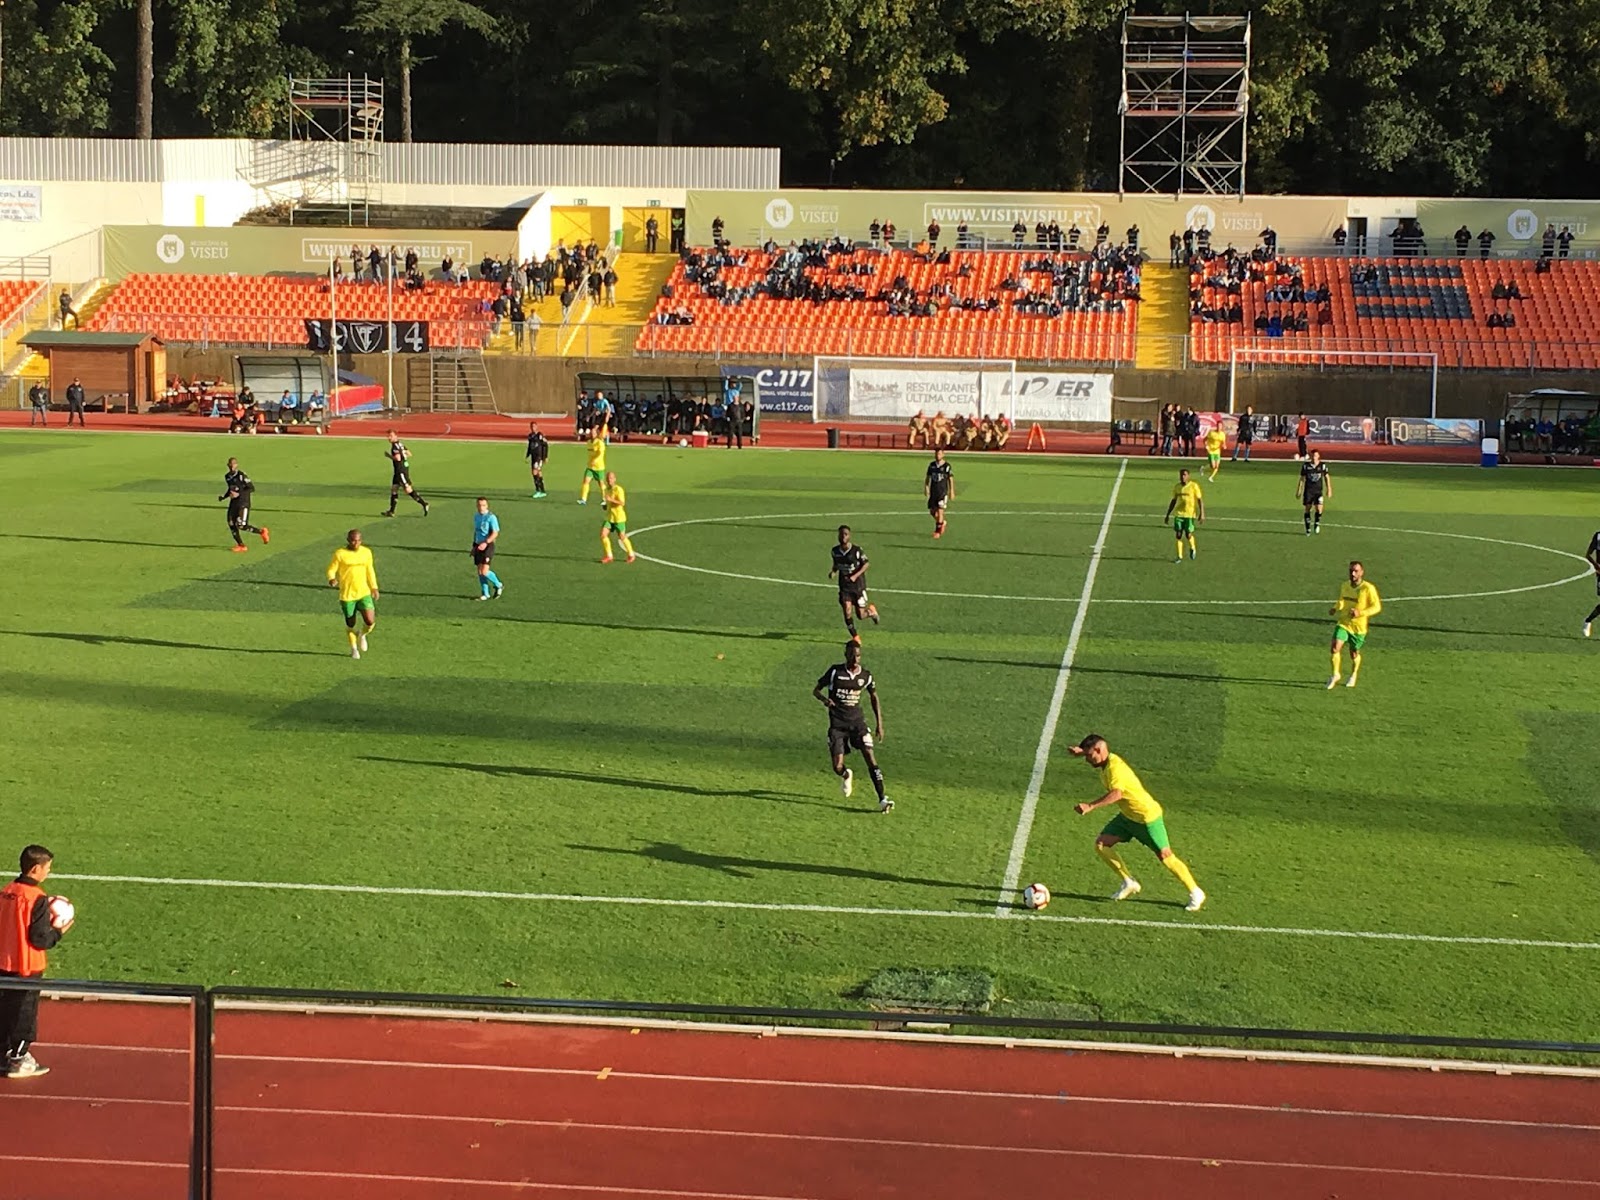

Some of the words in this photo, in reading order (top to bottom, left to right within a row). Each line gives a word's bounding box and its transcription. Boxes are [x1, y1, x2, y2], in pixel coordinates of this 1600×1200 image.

[800, 210, 839, 223] VISEU
[1222, 218, 1263, 231] VISEU
[190, 246, 229, 259] VISEU
[756, 369, 812, 387] C.117
[905, 382, 976, 393] RESTAURANTE
